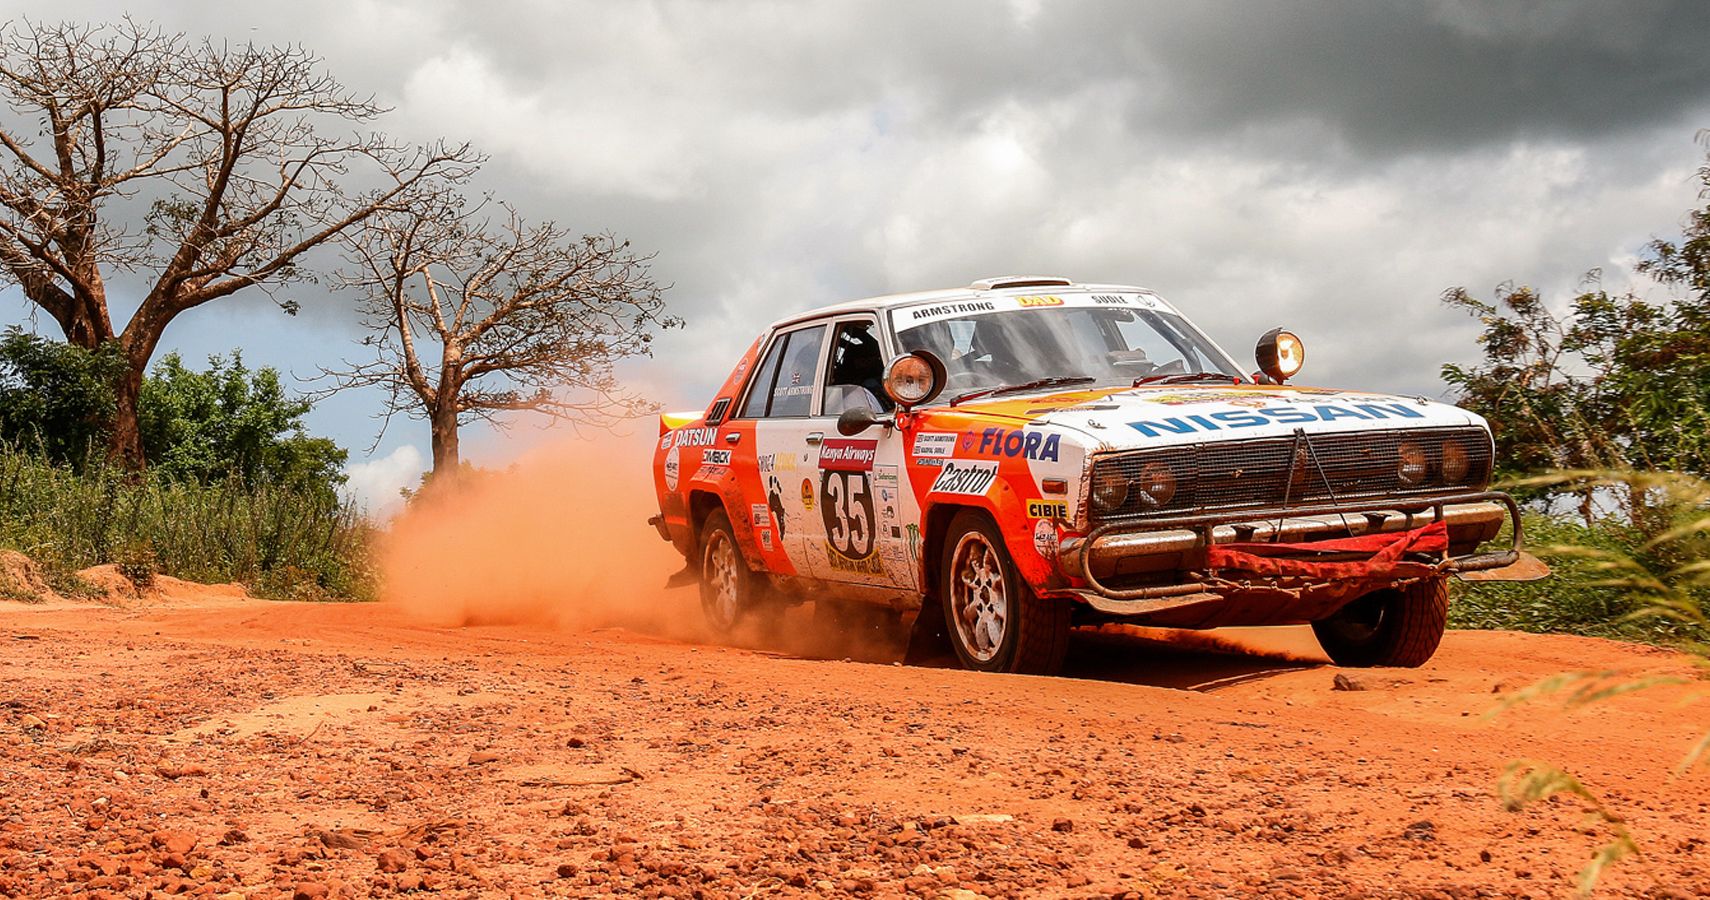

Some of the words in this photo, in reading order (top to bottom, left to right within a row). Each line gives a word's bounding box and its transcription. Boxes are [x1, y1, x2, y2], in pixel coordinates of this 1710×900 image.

[912, 301, 995, 320] ARMSTRONG
[1091, 295, 1128, 304] SUDLE
[1127, 404, 1425, 437] NISSAN
[675, 428, 718, 447] DATSUN
[979, 428, 1061, 462] FLORA
[820, 445, 843, 462] Kenya
[842, 445, 875, 463] Airways
[932, 462, 998, 494] Castrol
[827, 472, 869, 555] 35
